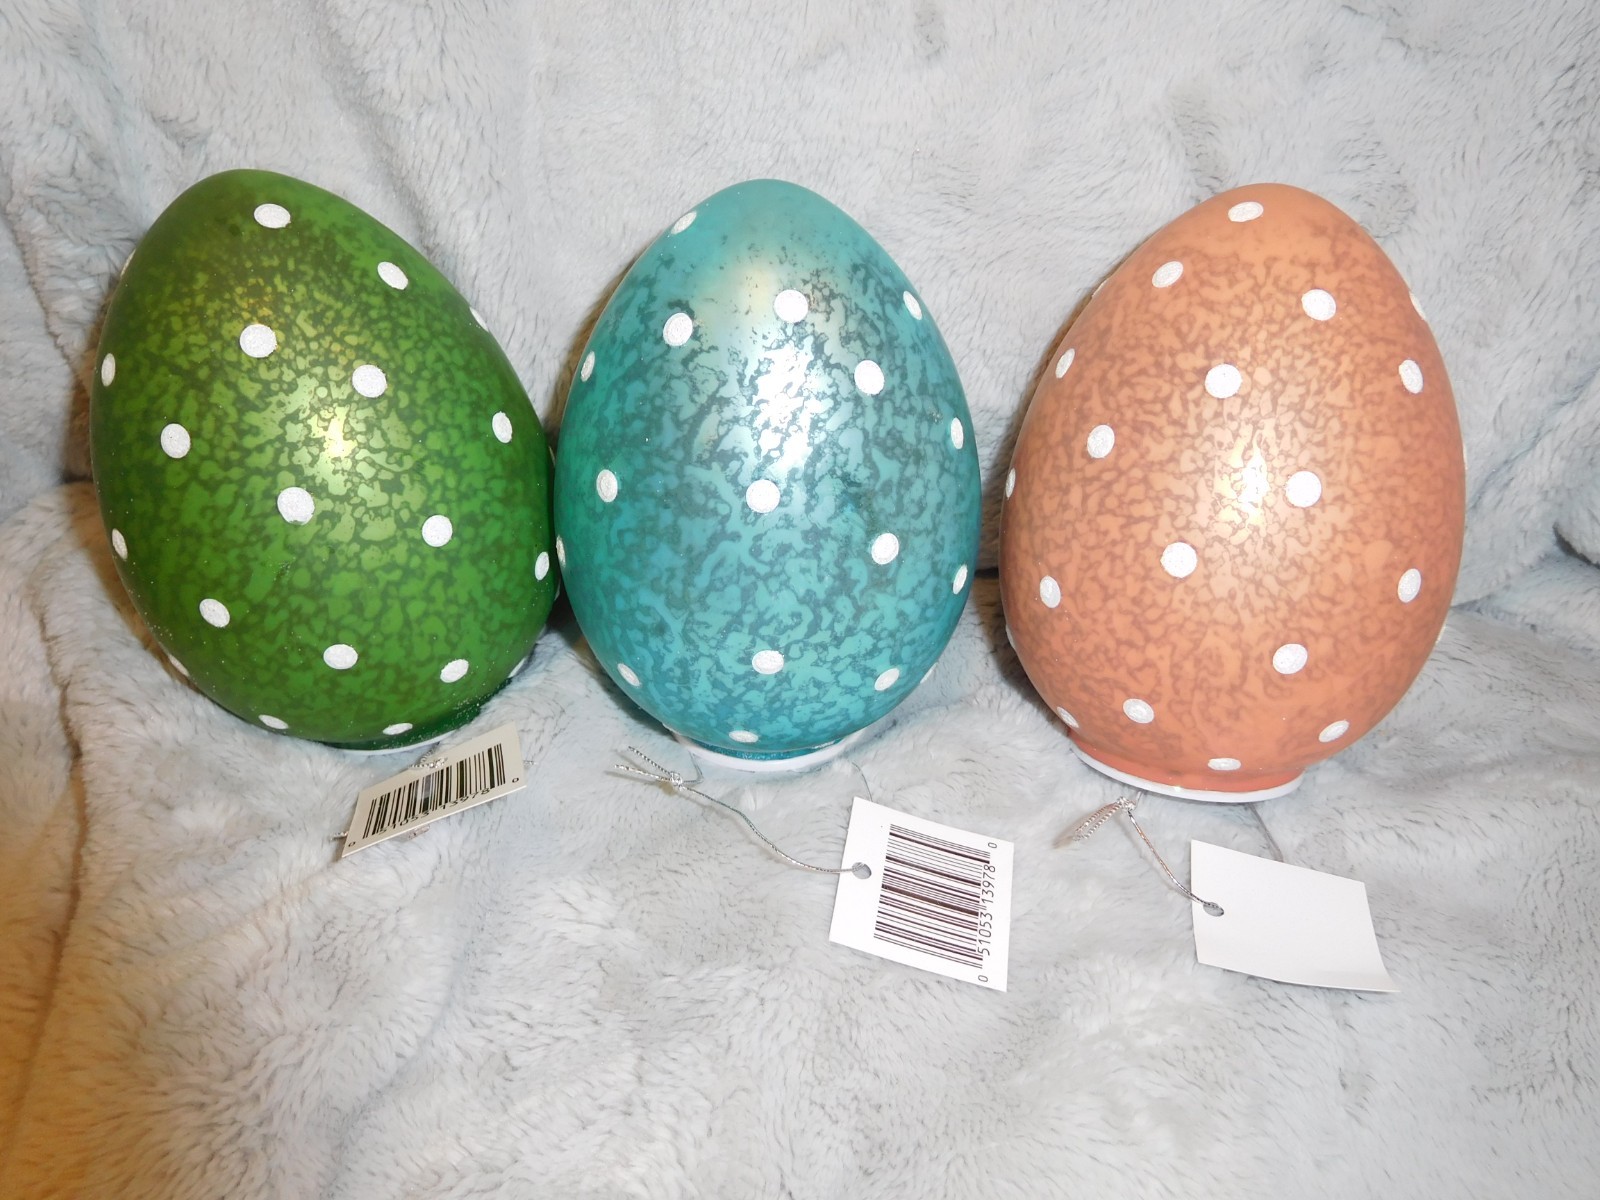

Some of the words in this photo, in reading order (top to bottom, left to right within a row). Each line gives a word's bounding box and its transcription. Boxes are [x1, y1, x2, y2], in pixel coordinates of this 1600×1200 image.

[379, 811, 430, 834] 51053
[440, 787, 490, 810] 13978
[982, 865, 996, 904] 13978
[977, 912, 992, 956] 51053
[978, 975, 988, 983] 0
